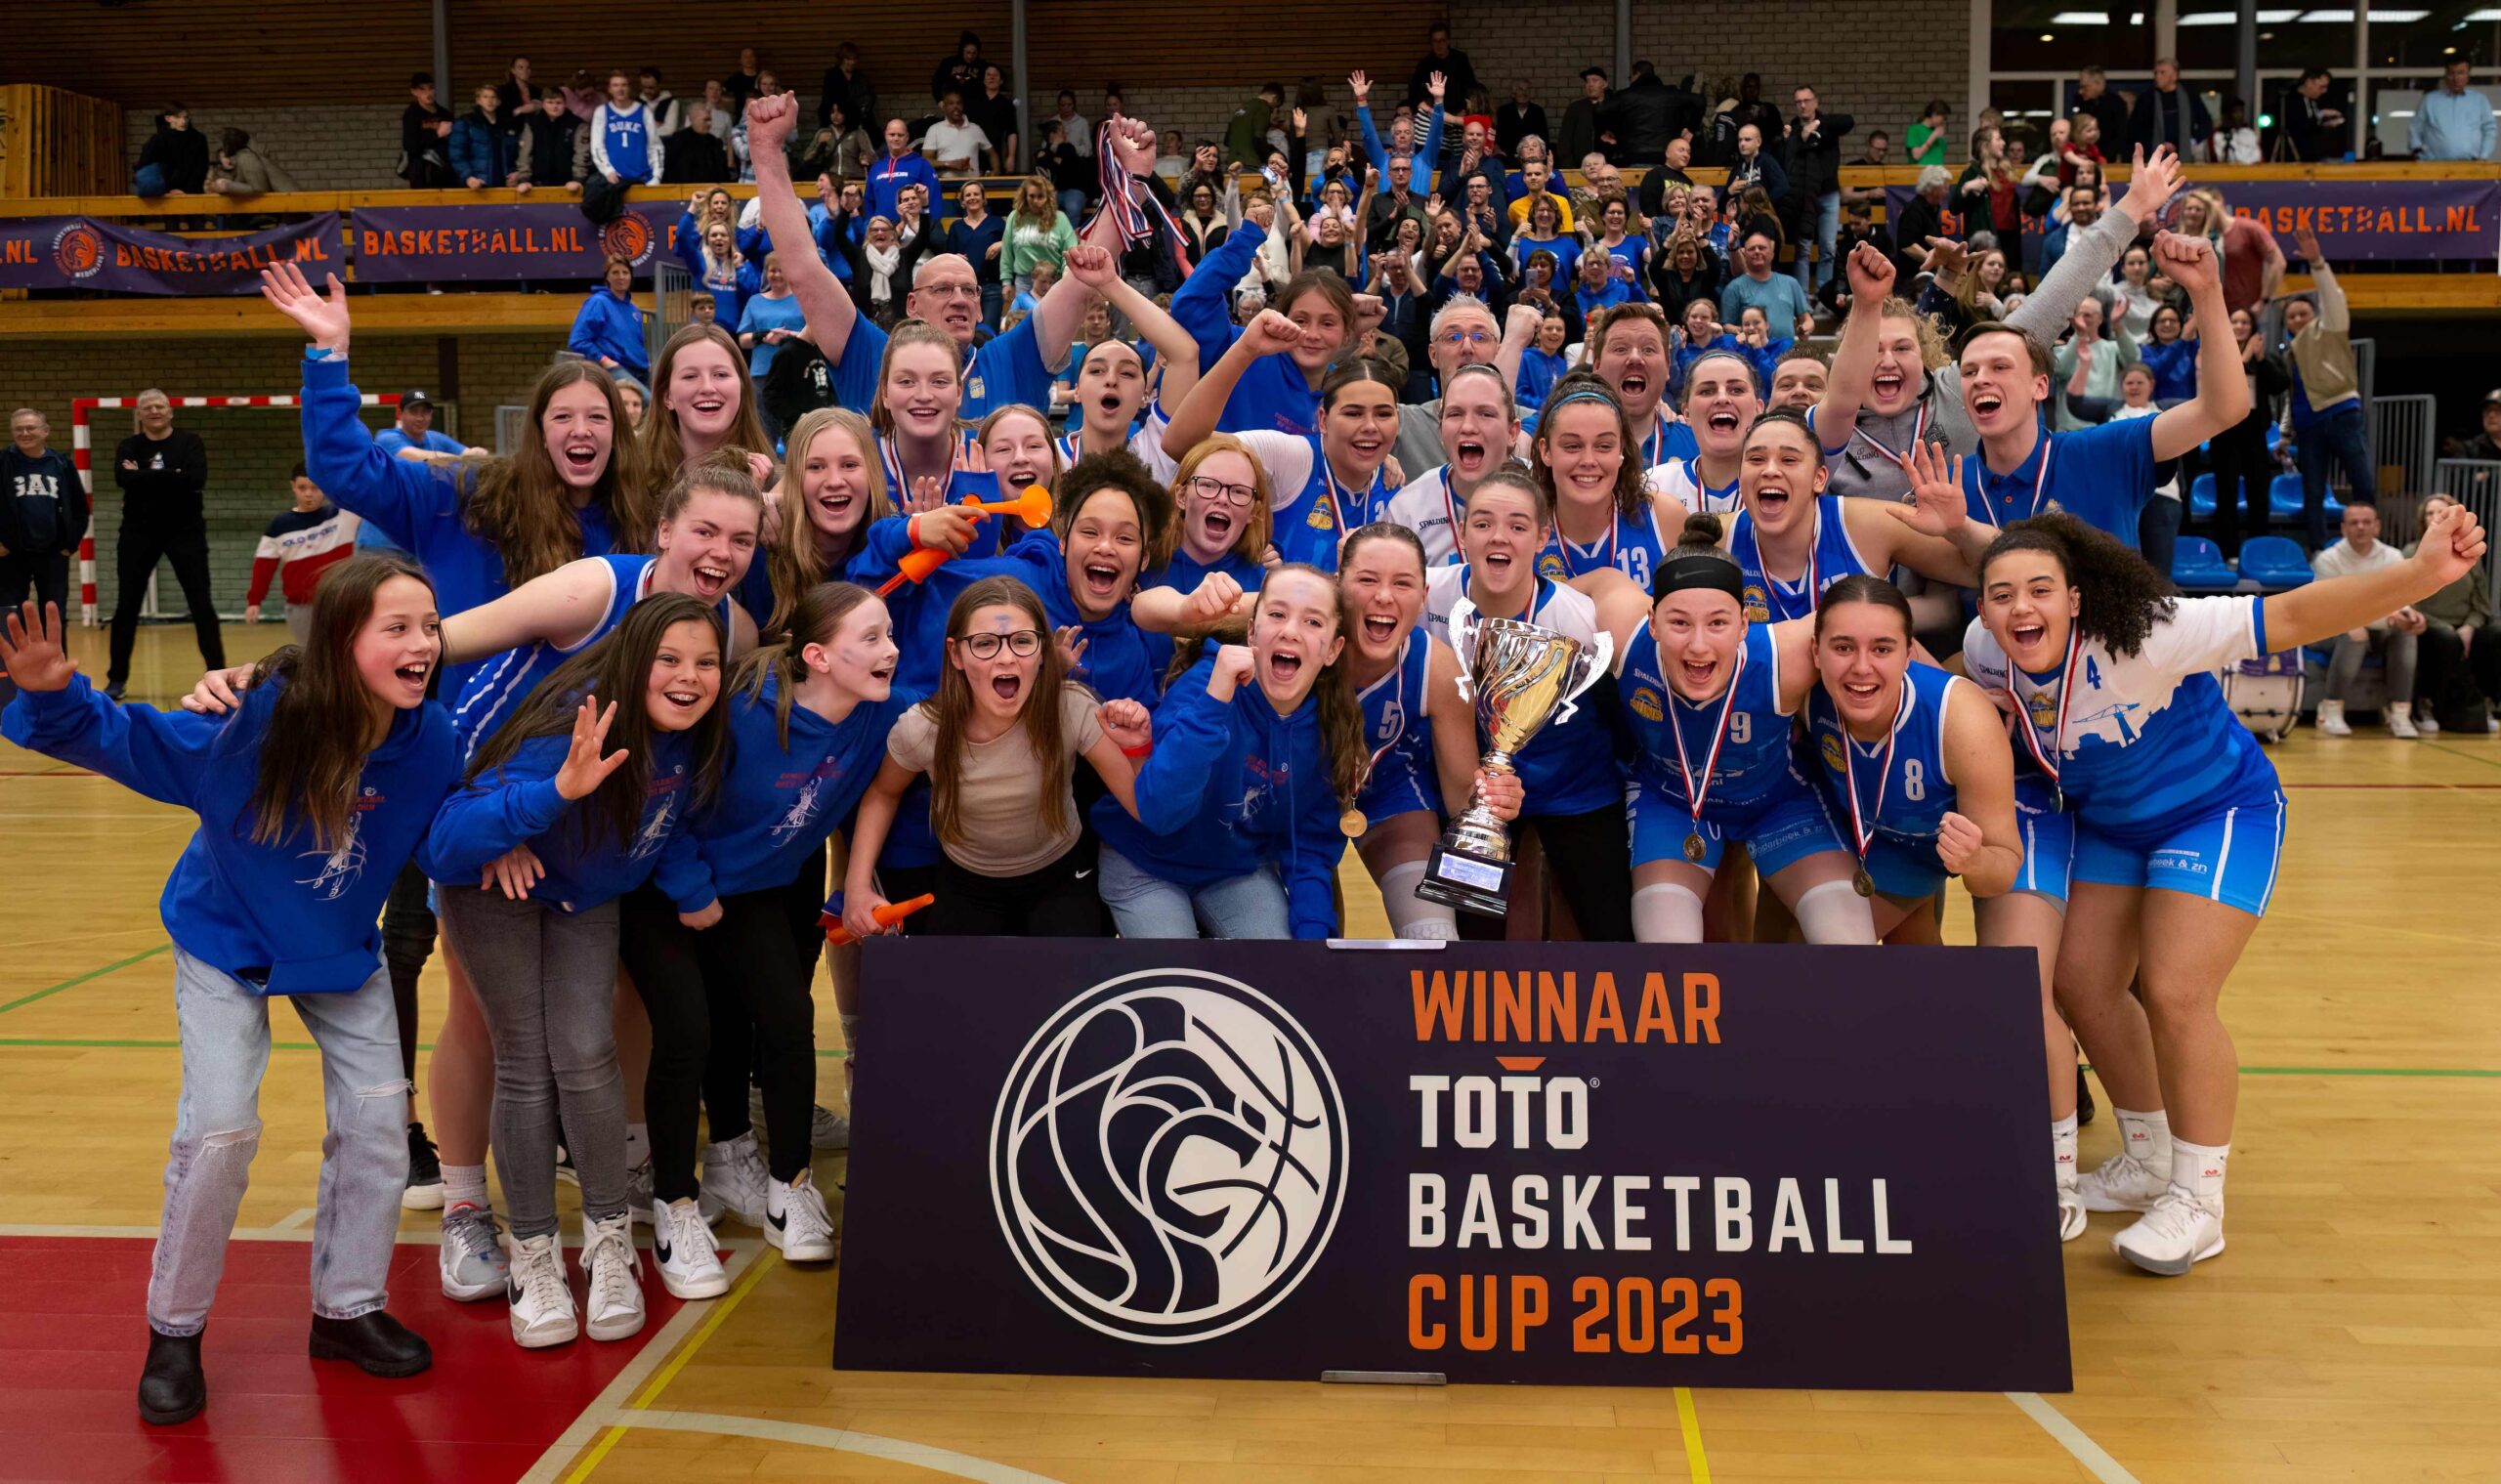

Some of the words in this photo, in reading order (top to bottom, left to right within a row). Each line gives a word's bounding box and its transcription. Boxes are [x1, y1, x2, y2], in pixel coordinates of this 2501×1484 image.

[609, 121, 642, 133] DUKE
[621, 132, 628, 148] 1
[363, 227, 584, 255] BASKETBALL.NL
[1617, 546, 1651, 590] 13
[2087, 655, 2101, 690] 4
[1378, 700, 1401, 740] 5
[1730, 711, 1752, 744] 9
[1905, 758, 1926, 801] 8
[1411, 970, 1720, 1043] WINNAAR
[1410, 1173, 1913, 1254] BASKETBALL
[1409, 1275, 1548, 1351] CUP
[1573, 1277, 1743, 1355] 2023
